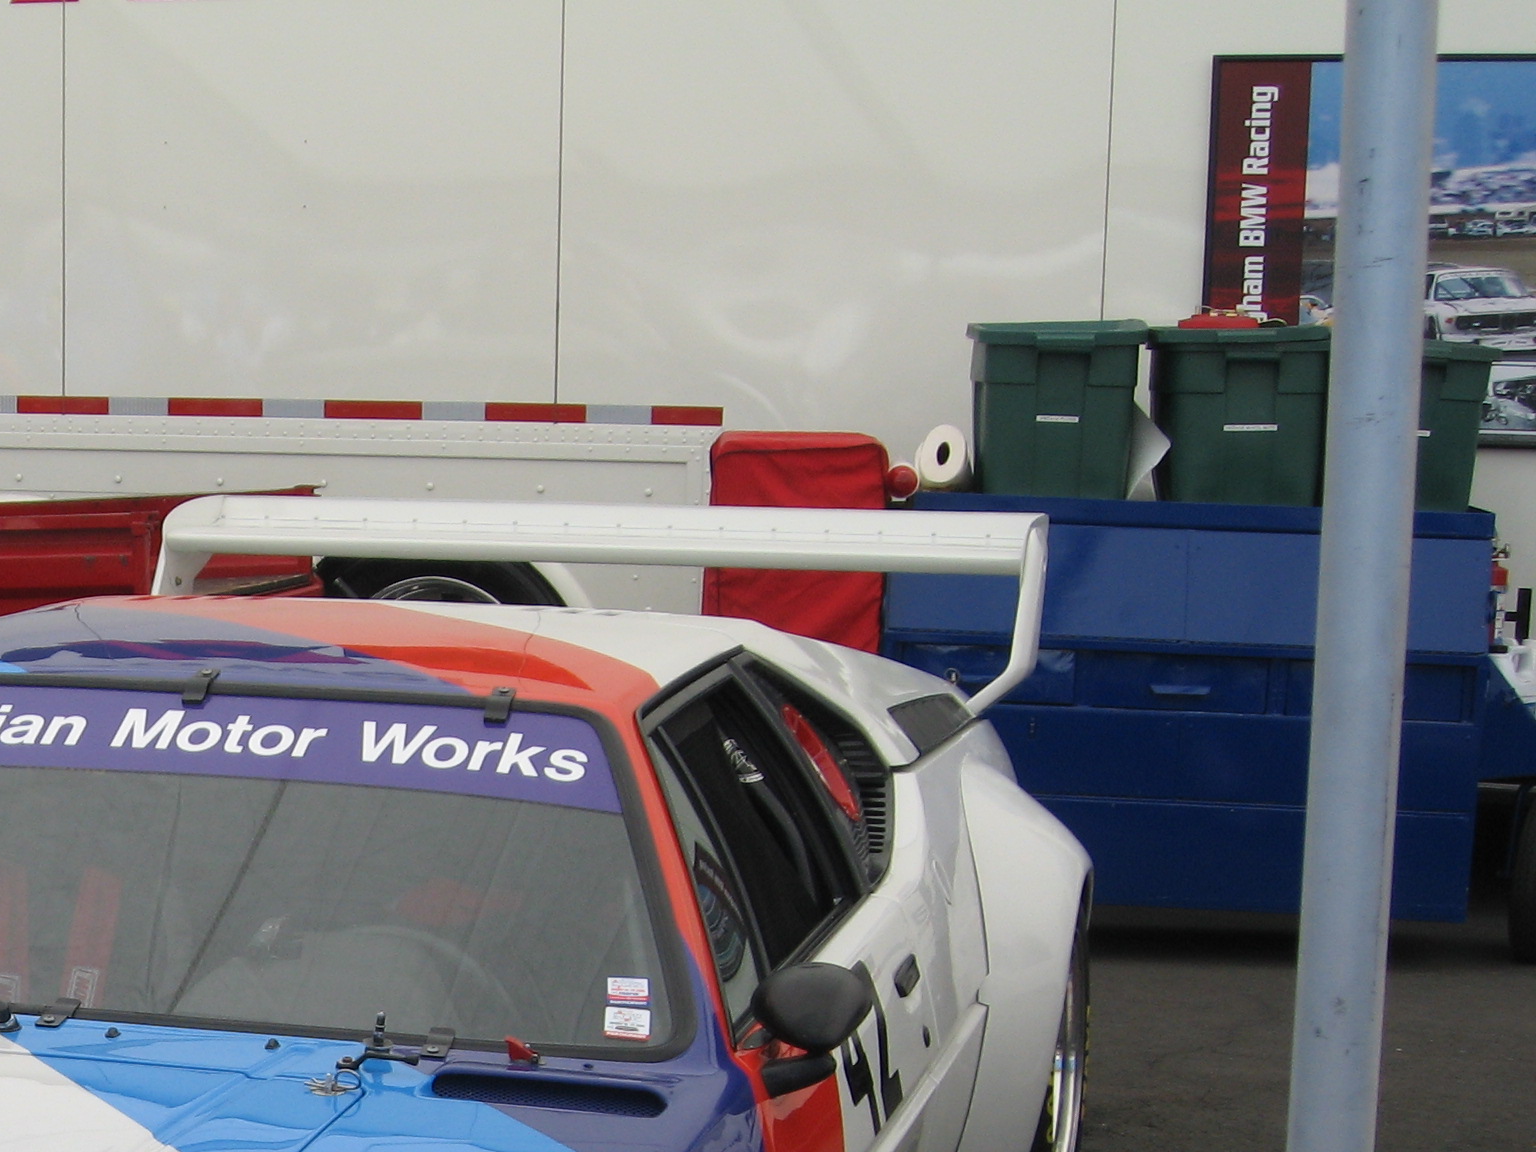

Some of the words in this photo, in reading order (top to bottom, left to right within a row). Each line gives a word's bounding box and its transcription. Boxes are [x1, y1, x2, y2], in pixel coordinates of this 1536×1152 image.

[1242, 85, 1280, 176] Racing
[1238, 183, 1268, 247] BMW
[109, 707, 328, 759] Motor
[360, 720, 589, 783] Works
